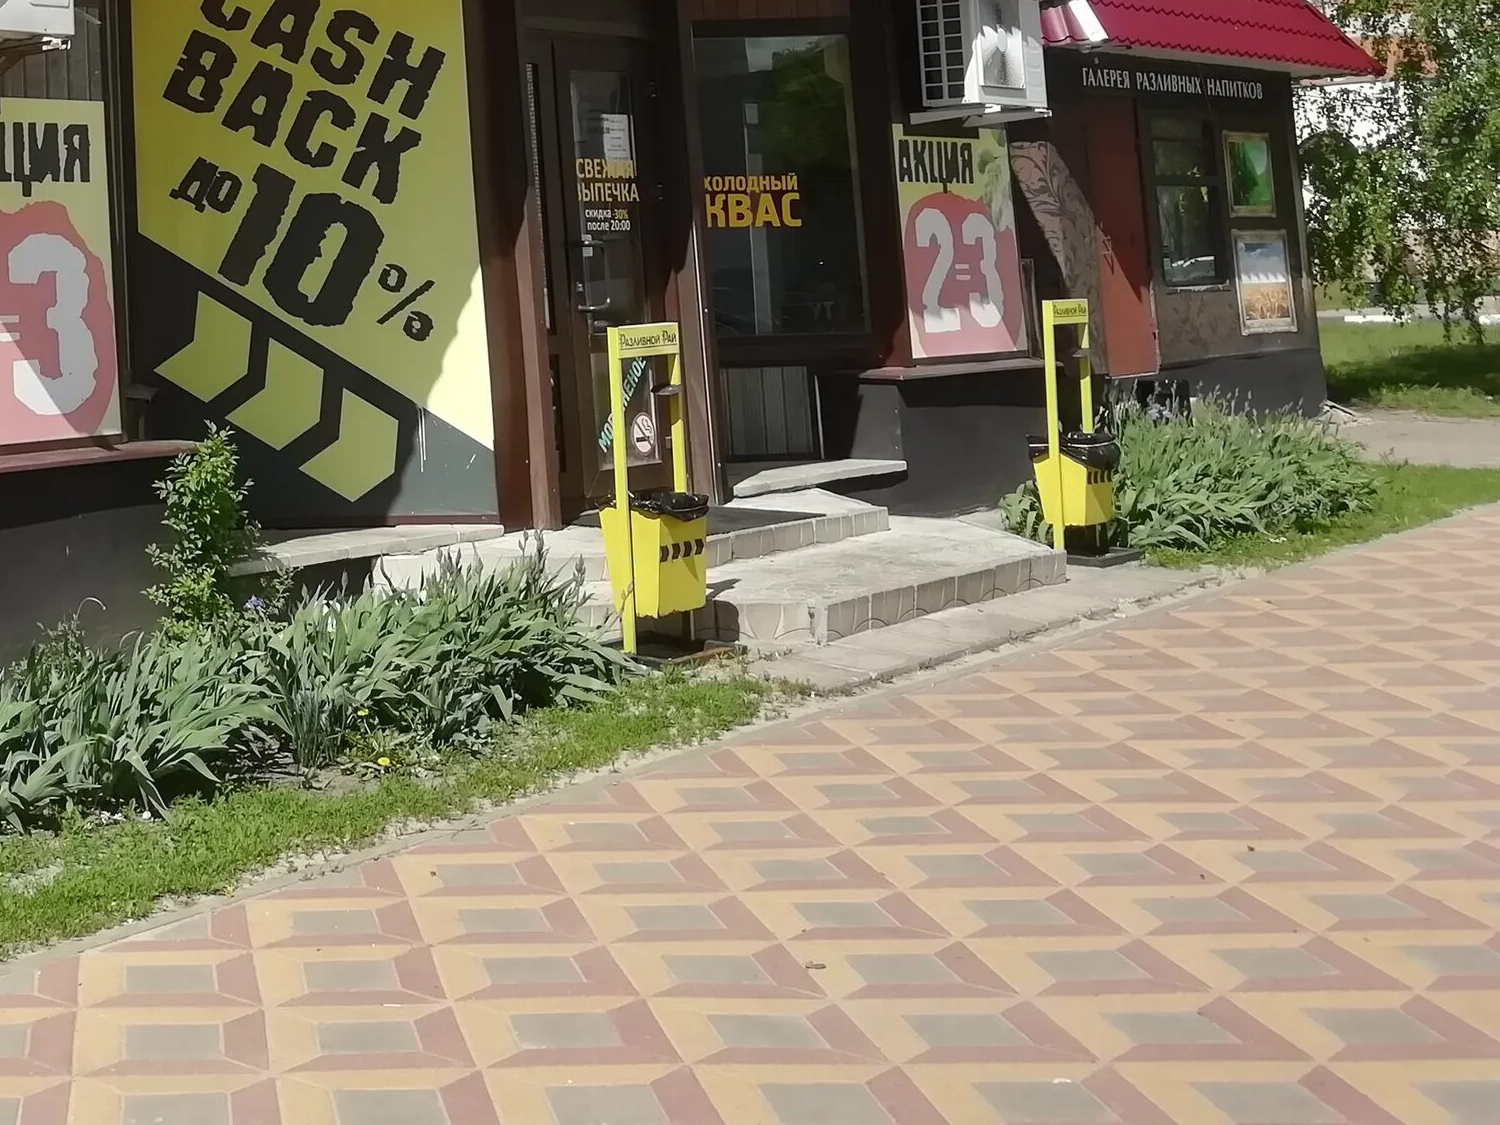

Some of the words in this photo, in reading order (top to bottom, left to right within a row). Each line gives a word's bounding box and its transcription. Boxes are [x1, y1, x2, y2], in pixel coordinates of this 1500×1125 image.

[1082, 67, 1131, 89] ГАЛЕРЕЯ
[1136, 72, 1202, 94] РАЗЛИВНЫХ
[1207, 78, 1263, 100] НАПИТКОВ
[162, 29, 422, 205] BACK
[898, 139, 974, 194] АКЦИЯ
[610, 220, 631, 231] 20:00
[705, 192, 803, 228] КВАС
